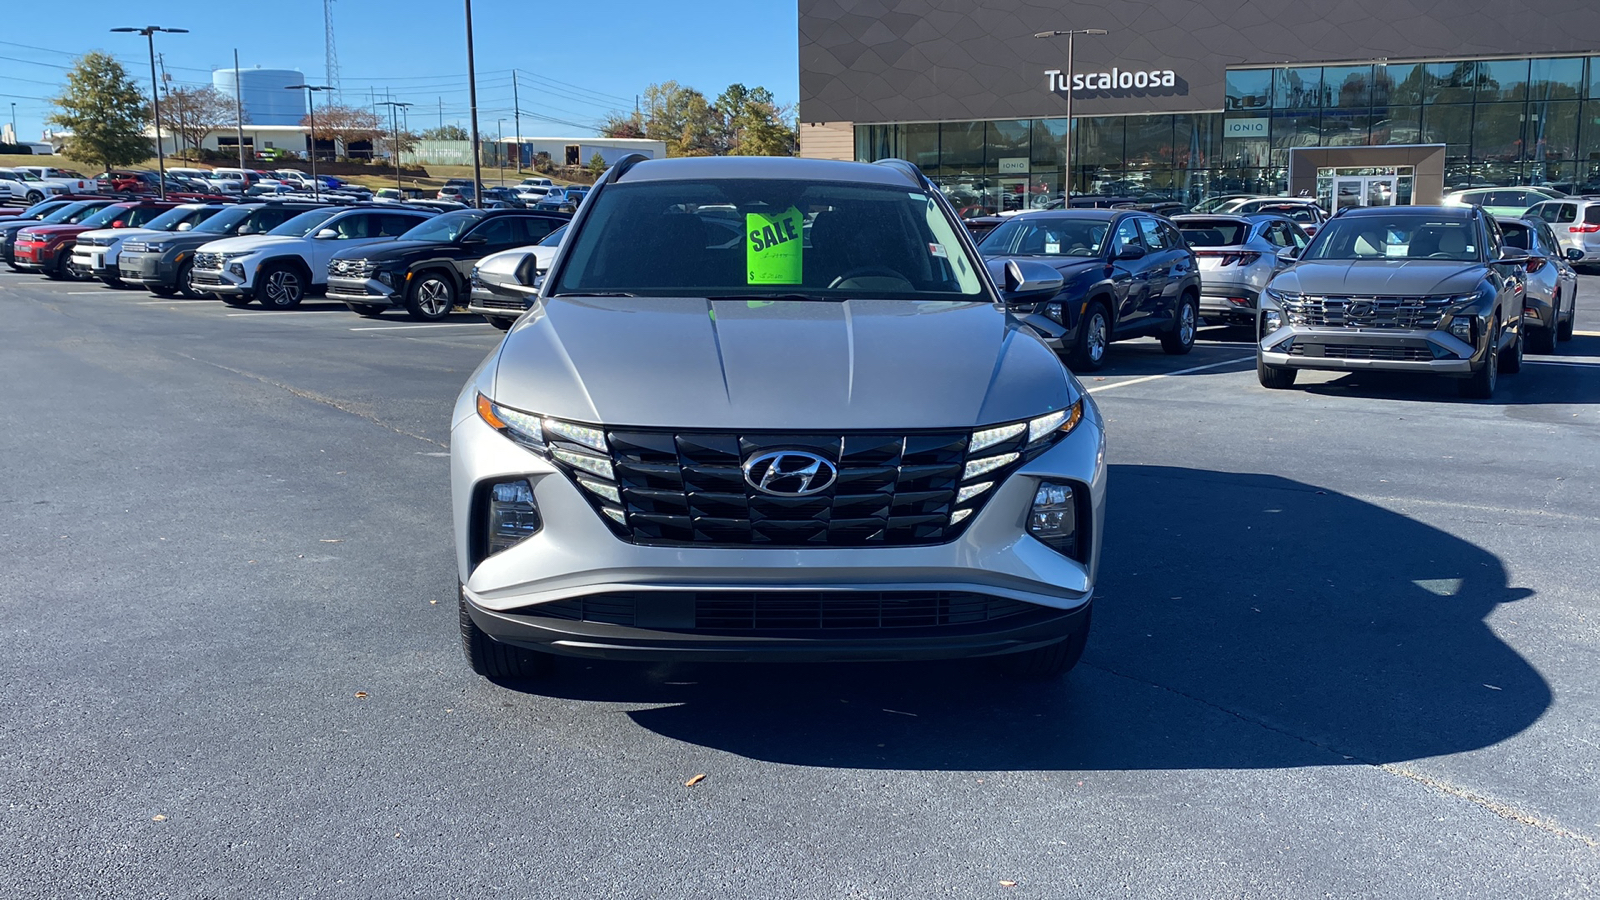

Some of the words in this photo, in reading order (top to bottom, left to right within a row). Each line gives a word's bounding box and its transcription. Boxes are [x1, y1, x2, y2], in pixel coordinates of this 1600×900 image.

[1044, 67, 1175, 91] Tuscaloosa
[1229, 123, 1263, 131] IONIQ
[749, 217, 799, 252] SALE
[749, 270, 755, 281] $
